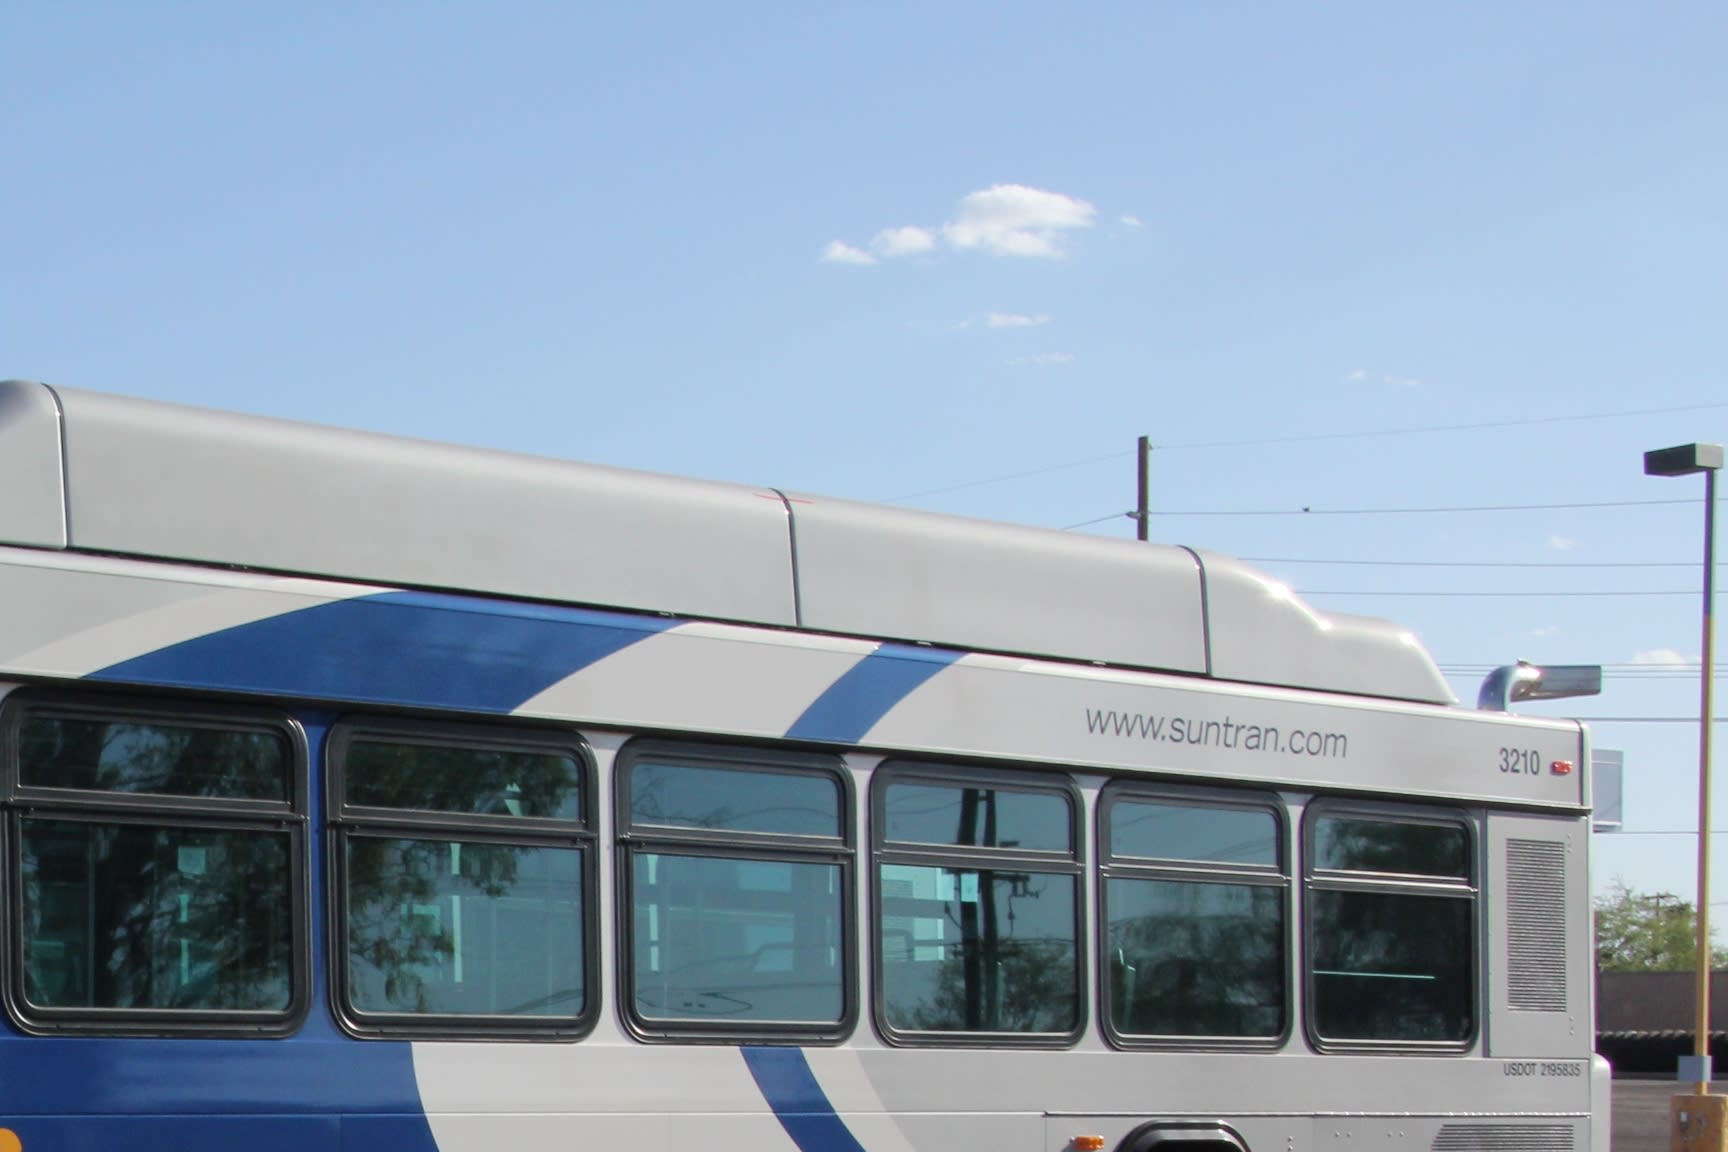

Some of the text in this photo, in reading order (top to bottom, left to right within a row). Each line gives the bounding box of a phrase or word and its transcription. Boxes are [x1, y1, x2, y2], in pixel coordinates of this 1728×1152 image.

[1085, 707, 1348, 758] www.suntran.com
[1498, 746, 1541, 776] 3210
[1503, 1062, 1582, 1077] USDOT 2195835
